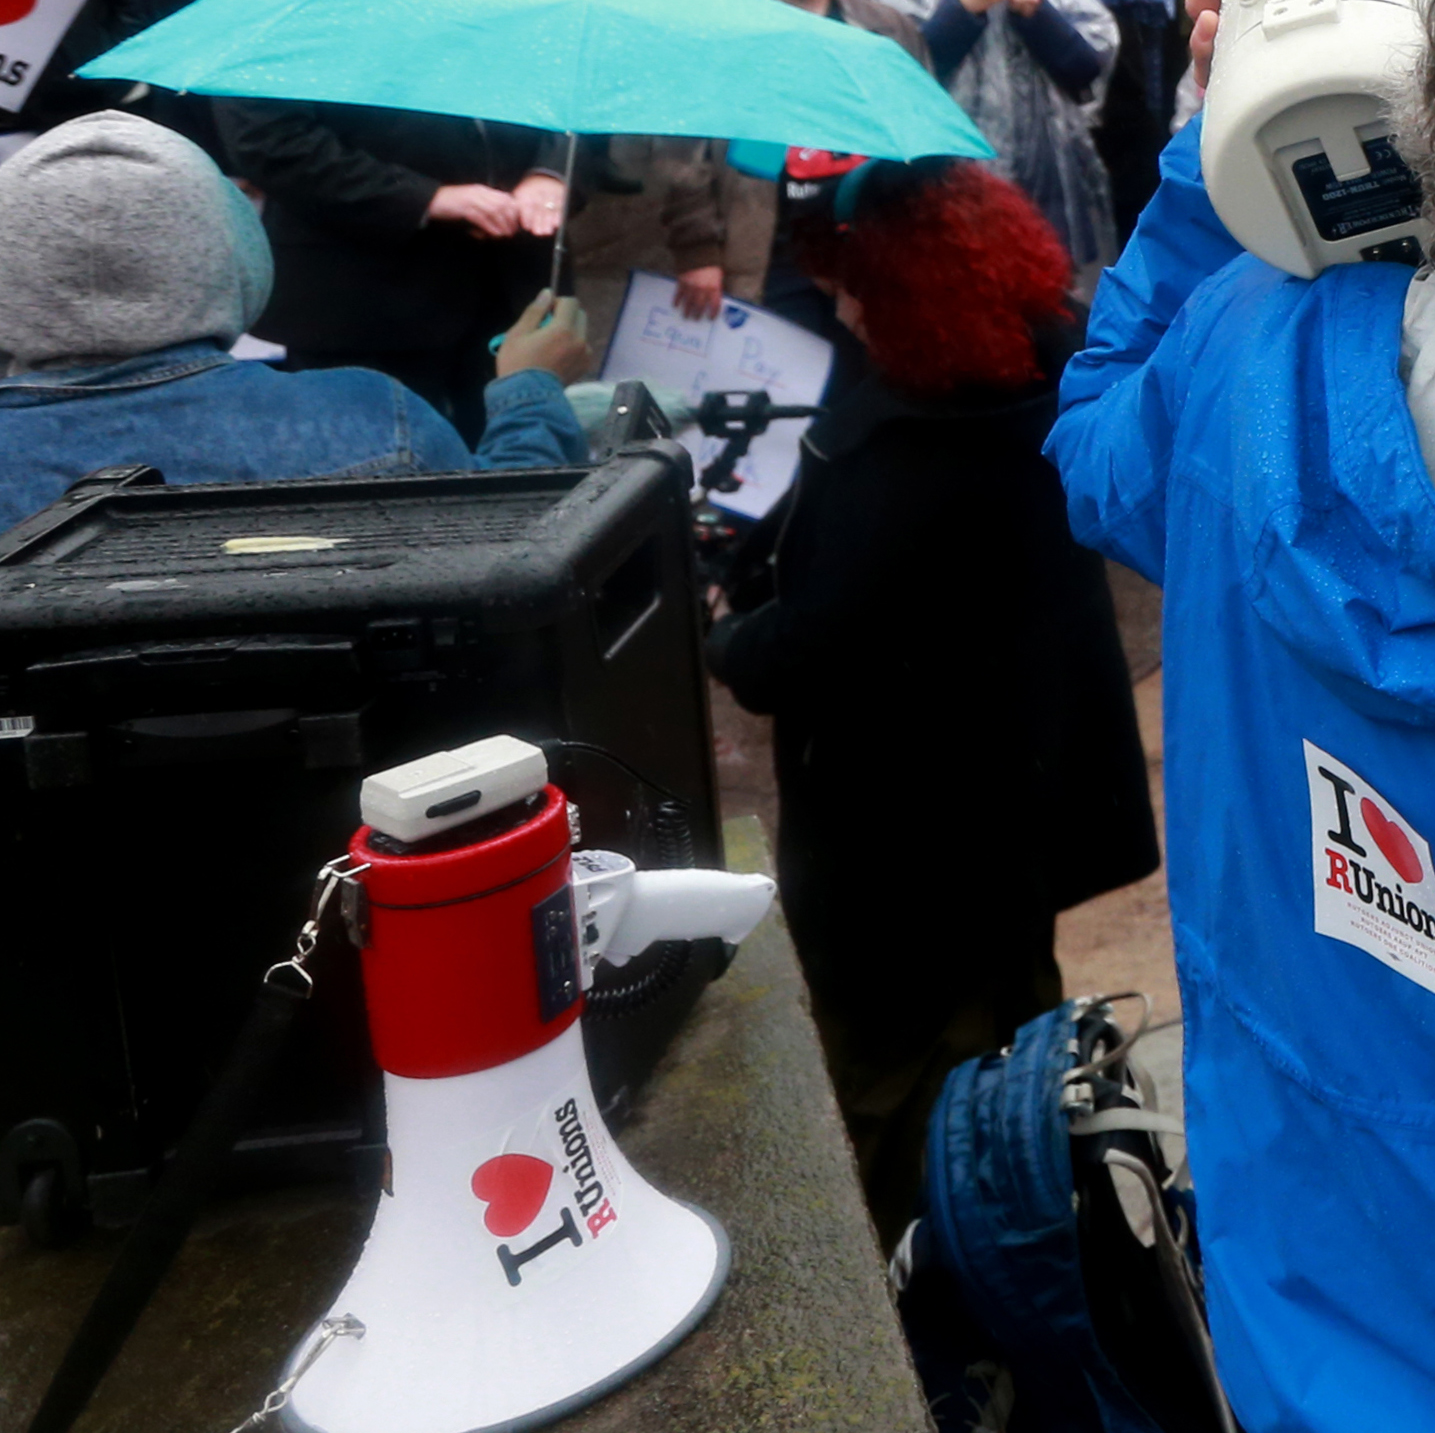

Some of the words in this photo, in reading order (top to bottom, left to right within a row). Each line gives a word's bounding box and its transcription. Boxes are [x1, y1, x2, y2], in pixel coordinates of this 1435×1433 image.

[1317, 765, 1367, 858] I
[553, 1097, 618, 1240] RUnions
[496, 1206, 584, 1288] I
